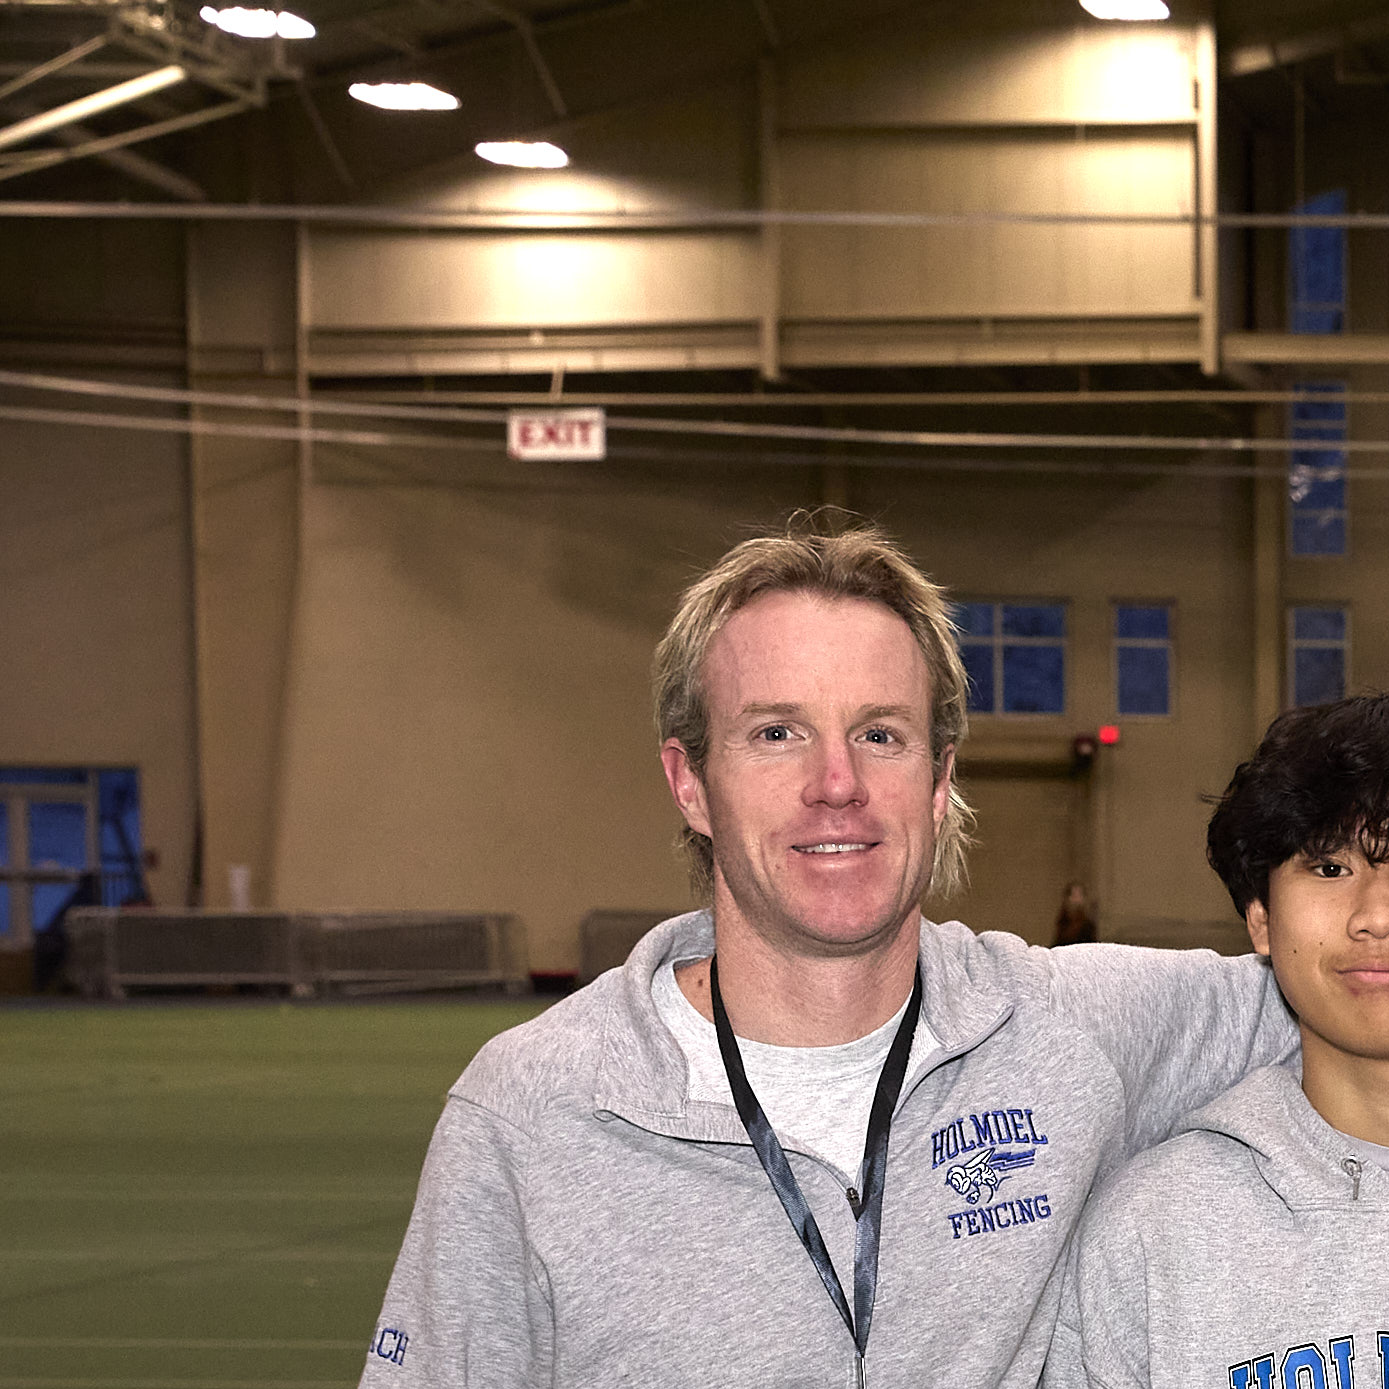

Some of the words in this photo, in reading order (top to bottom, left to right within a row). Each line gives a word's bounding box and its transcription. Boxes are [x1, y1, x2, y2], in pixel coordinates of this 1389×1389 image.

[519, 419, 592, 447] EXIT
[931, 1109, 1048, 1169] HOLMDEL
[947, 1194, 1052, 1239] FENCING
